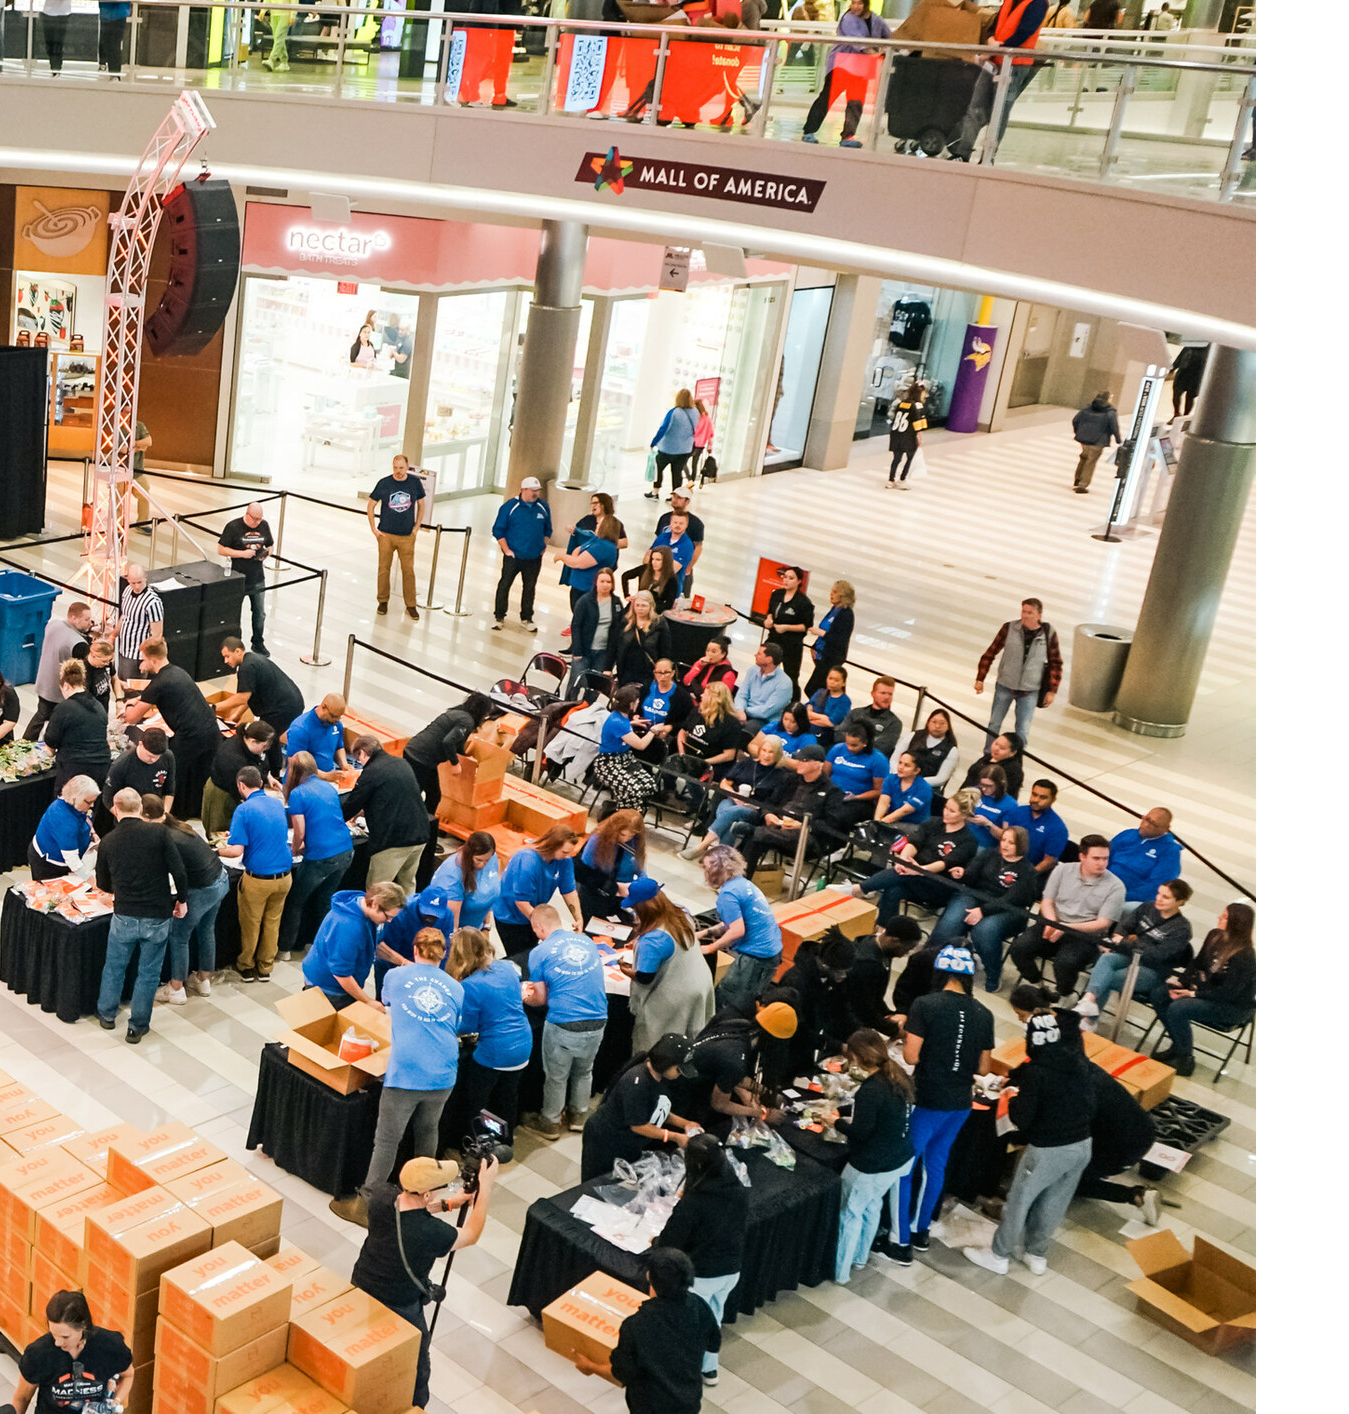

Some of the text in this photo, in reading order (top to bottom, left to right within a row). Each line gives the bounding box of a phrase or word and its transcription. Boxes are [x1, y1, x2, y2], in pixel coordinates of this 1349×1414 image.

[639, 165, 687, 187] MALL
[693, 172, 720, 191] OF
[290, 231, 373, 255] nectar
[299, 252, 359, 267] BATH TREATS
[5, 1109, 37, 1125] you
[26, 1125, 56, 1141] you
[88, 1132, 120, 1150] you
[138, 1132, 170, 1151] you
[17, 1158, 50, 1176] you
[153, 1146, 210, 1176] matter
[30, 1172, 87, 1201] matter
[190, 1171, 225, 1191] you
[56, 1190, 111, 1219] matter
[107, 1193, 166, 1224] matter
[207, 1188, 265, 1218] matter
[149, 1222, 183, 1243] you
[192, 1256, 228, 1278] you
[212, 1273, 272, 1309] matter
[293, 1282, 328, 1305] you
[320, 1304, 355, 1326] you
[344, 1322, 400, 1357] matter
[248, 1379, 283, 1403] you
